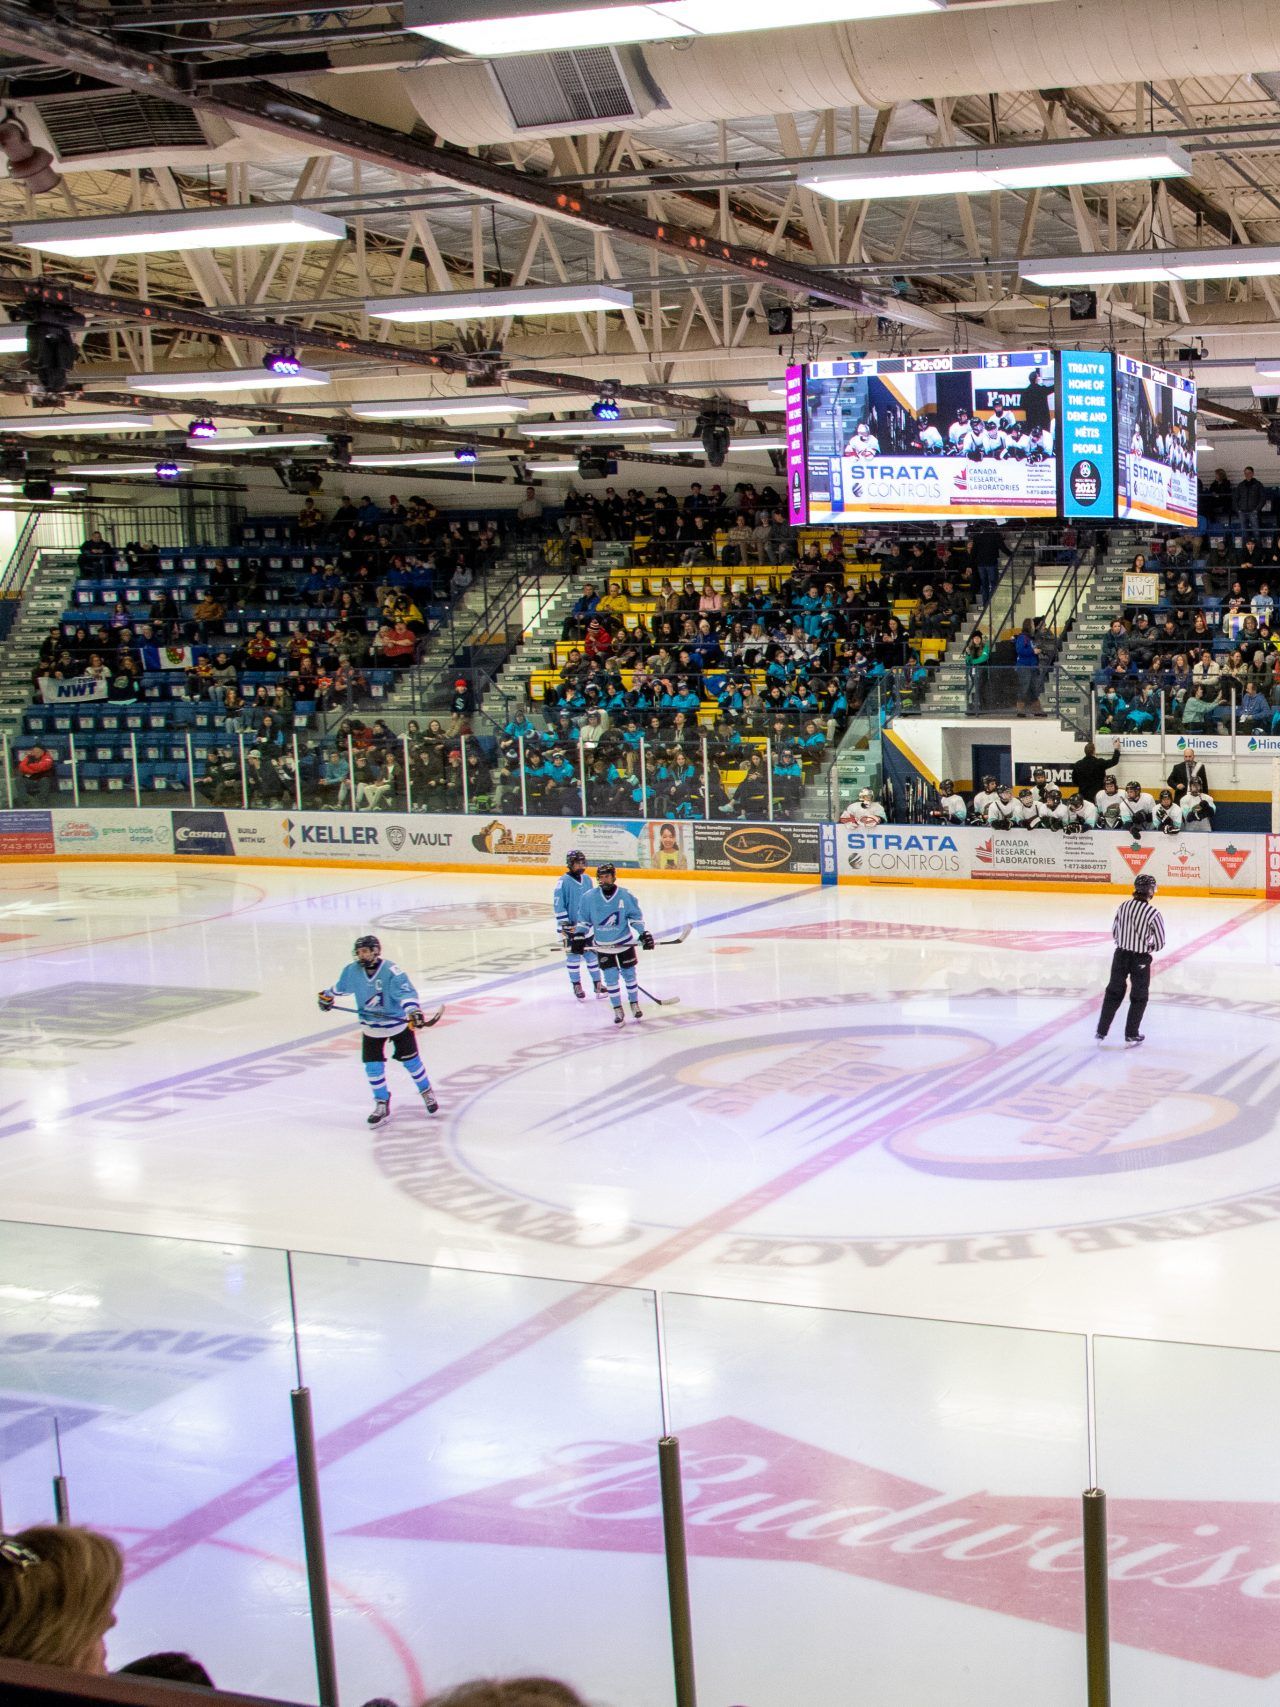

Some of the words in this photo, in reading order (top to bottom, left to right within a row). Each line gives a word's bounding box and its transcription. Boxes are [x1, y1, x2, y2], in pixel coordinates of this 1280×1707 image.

[912, 358, 950, 371] 20:00
[1068, 363, 1098, 374] TREATY
[1069, 380, 1091, 390] HOME
[1093, 381, 1105, 390] OF
[1068, 395, 1084, 405] THE
[1084, 396, 1106, 407] CREE
[1067, 412, 1088, 422] DENE
[1089, 412, 1107, 423] AND
[1072, 443, 1103, 454] PEOPLE
[851, 465, 939, 480] STRATA
[1133, 463, 1164, 485] STRATA
[867, 482, 941, 498] CONTROLS
[969, 484, 1020, 492] LABORATORIES
[1074, 483, 1097, 494] 2023
[1127, 585, 1156, 597] NWT
[57, 682, 97, 698] NWT
[1119, 737, 1148, 749] Hines
[1187, 738, 1219, 749] Hines
[67, 822, 89, 830] Clean
[102, 827, 126, 836] green
[128, 826, 154, 834] bottle
[129, 834, 154, 845] depot
[175, 826, 227, 842] Casman
[301, 825, 379, 845] KELLER
[408, 832, 453, 847] VAULT
[737, 835, 748, 848] A
[847, 833, 959, 852] STRATA
[994, 839, 1029, 847] CANADA
[822, 824, 835, 873] MOB
[995, 848, 1036, 857] RESEARCH
[764, 849, 775, 862] Z
[995, 856, 1057, 866] LABORATORIES
[868, 853, 961, 872] CONTROLS
[1130, 858, 1142, 866] TIRE
[1167, 865, 1201, 873] Jumpstart
